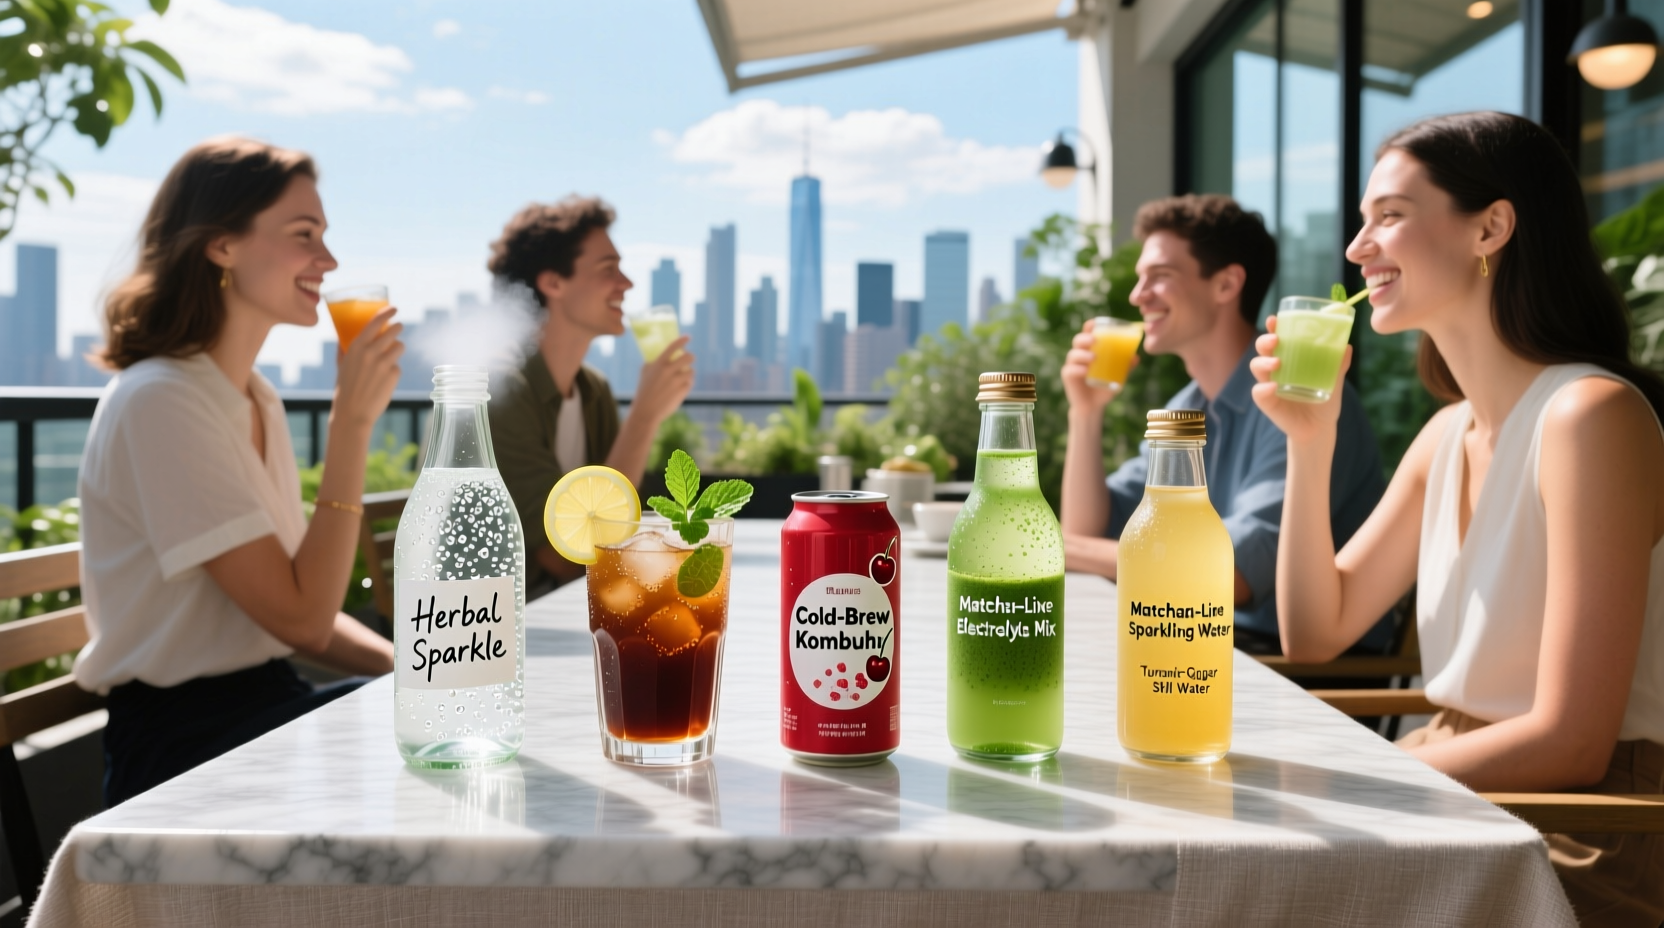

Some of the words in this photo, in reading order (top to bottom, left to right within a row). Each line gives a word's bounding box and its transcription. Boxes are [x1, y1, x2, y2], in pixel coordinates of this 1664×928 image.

[411, 591, 502, 634] Herbal
[796, 605, 890, 626] Cold-Brew
[1034, 619, 1056, 637] Mix
[1129, 621, 1194, 642] Sparkling
[412, 629, 507, 683] Sparkle
[1177, 682, 1210, 694] Water
